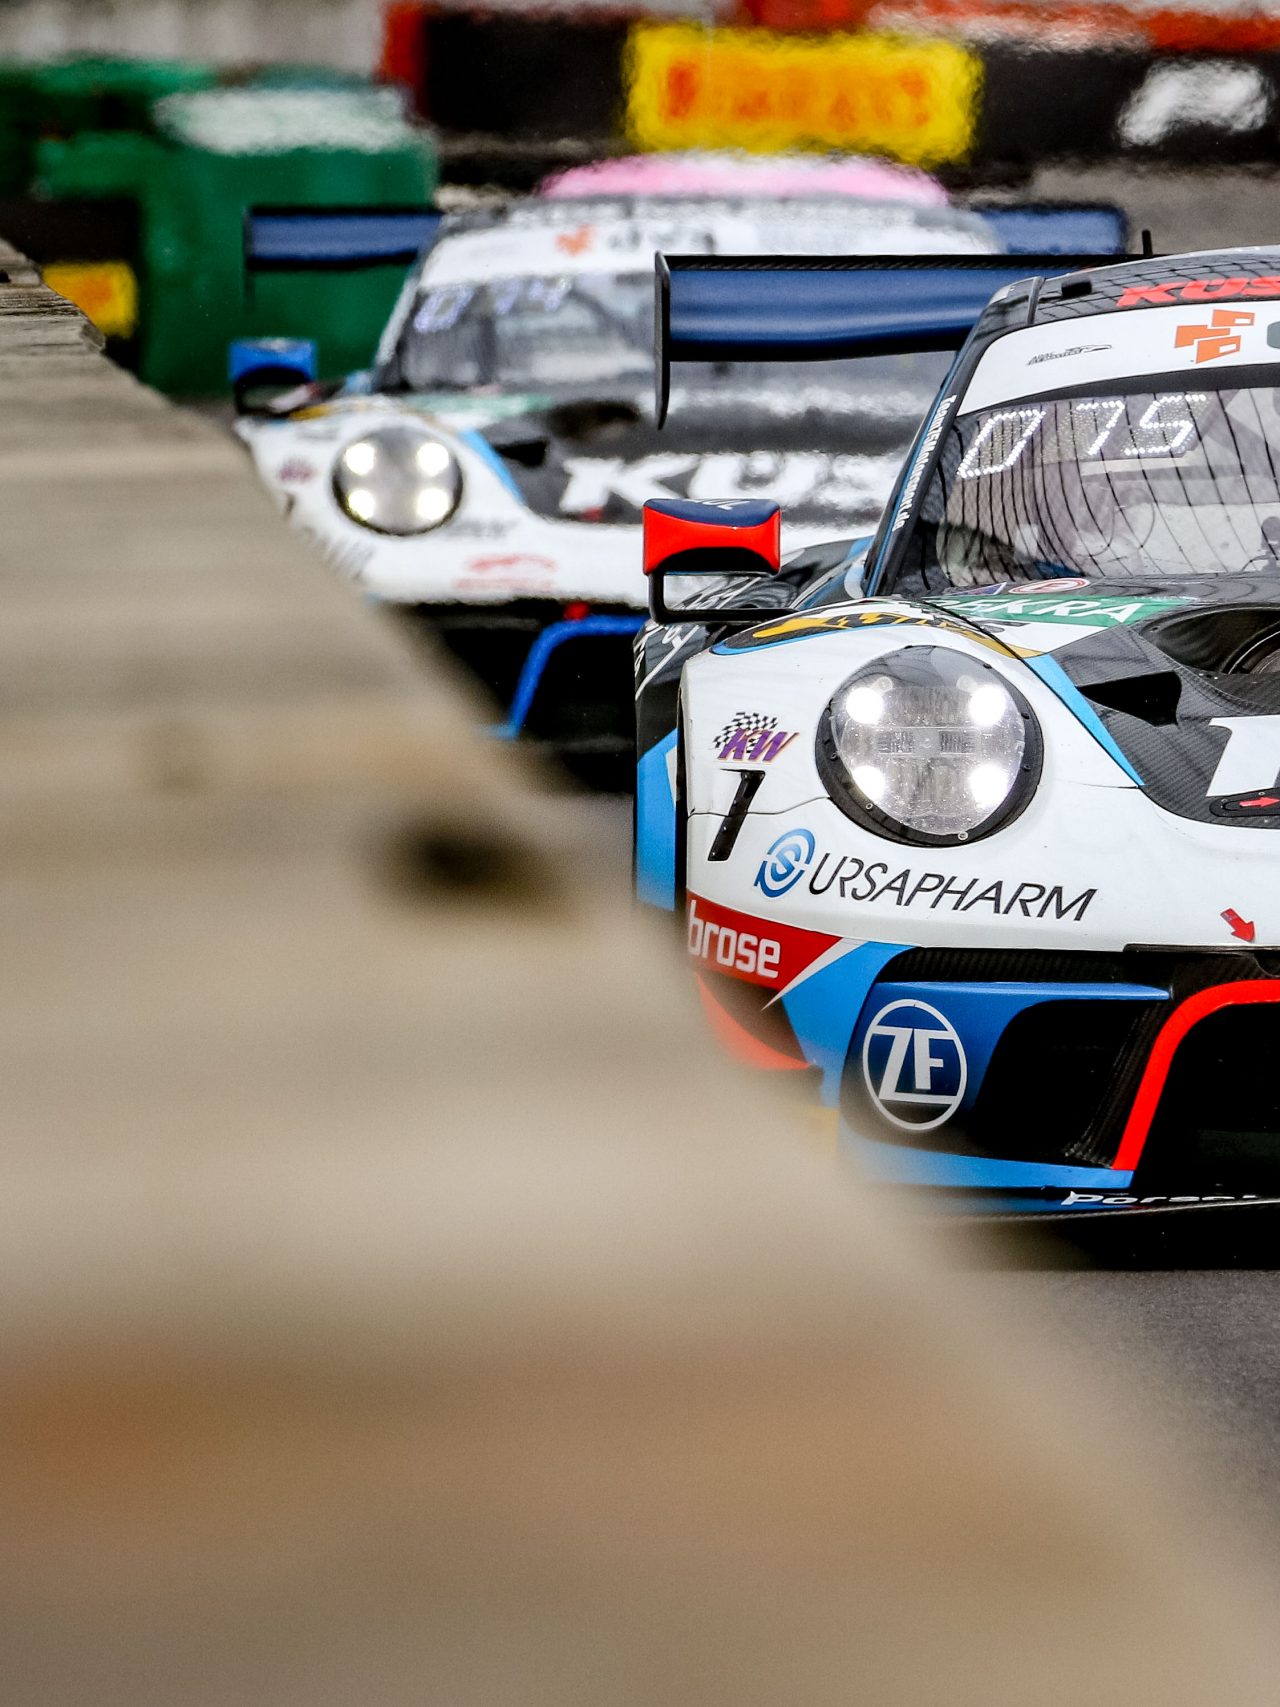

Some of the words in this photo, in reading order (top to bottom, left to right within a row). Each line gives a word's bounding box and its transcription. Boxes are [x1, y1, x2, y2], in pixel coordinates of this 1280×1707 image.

[716, 728, 800, 763] KW
[809, 852, 1097, 922] URSAPHARM
[688, 900, 781, 979] brose
[868, 1025, 964, 1105] ZF
